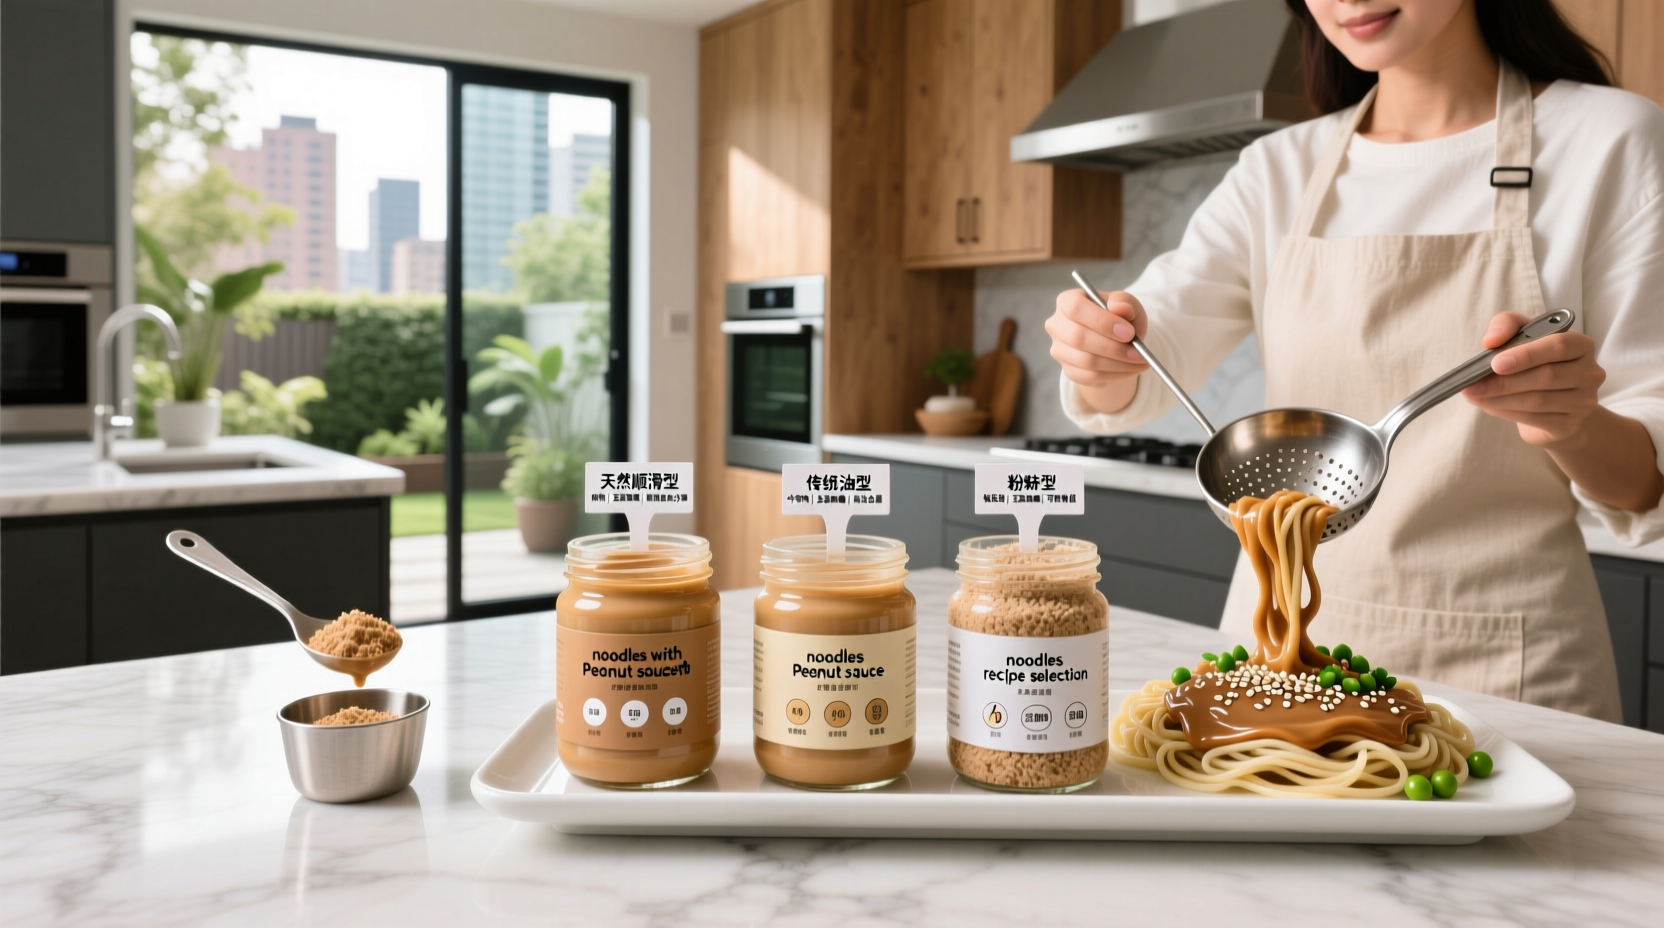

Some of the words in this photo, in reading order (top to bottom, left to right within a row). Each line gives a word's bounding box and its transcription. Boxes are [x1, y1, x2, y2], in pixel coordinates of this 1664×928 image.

[600, 472, 679, 490] 天然顺滑型
[592, 647, 647, 662] noodles
[651, 645, 682, 661] with
[807, 648, 864, 663] noodles
[1006, 652, 1063, 667] noodles
[844, 666, 885, 679] sauce
[1030, 667, 1088, 682] selection
